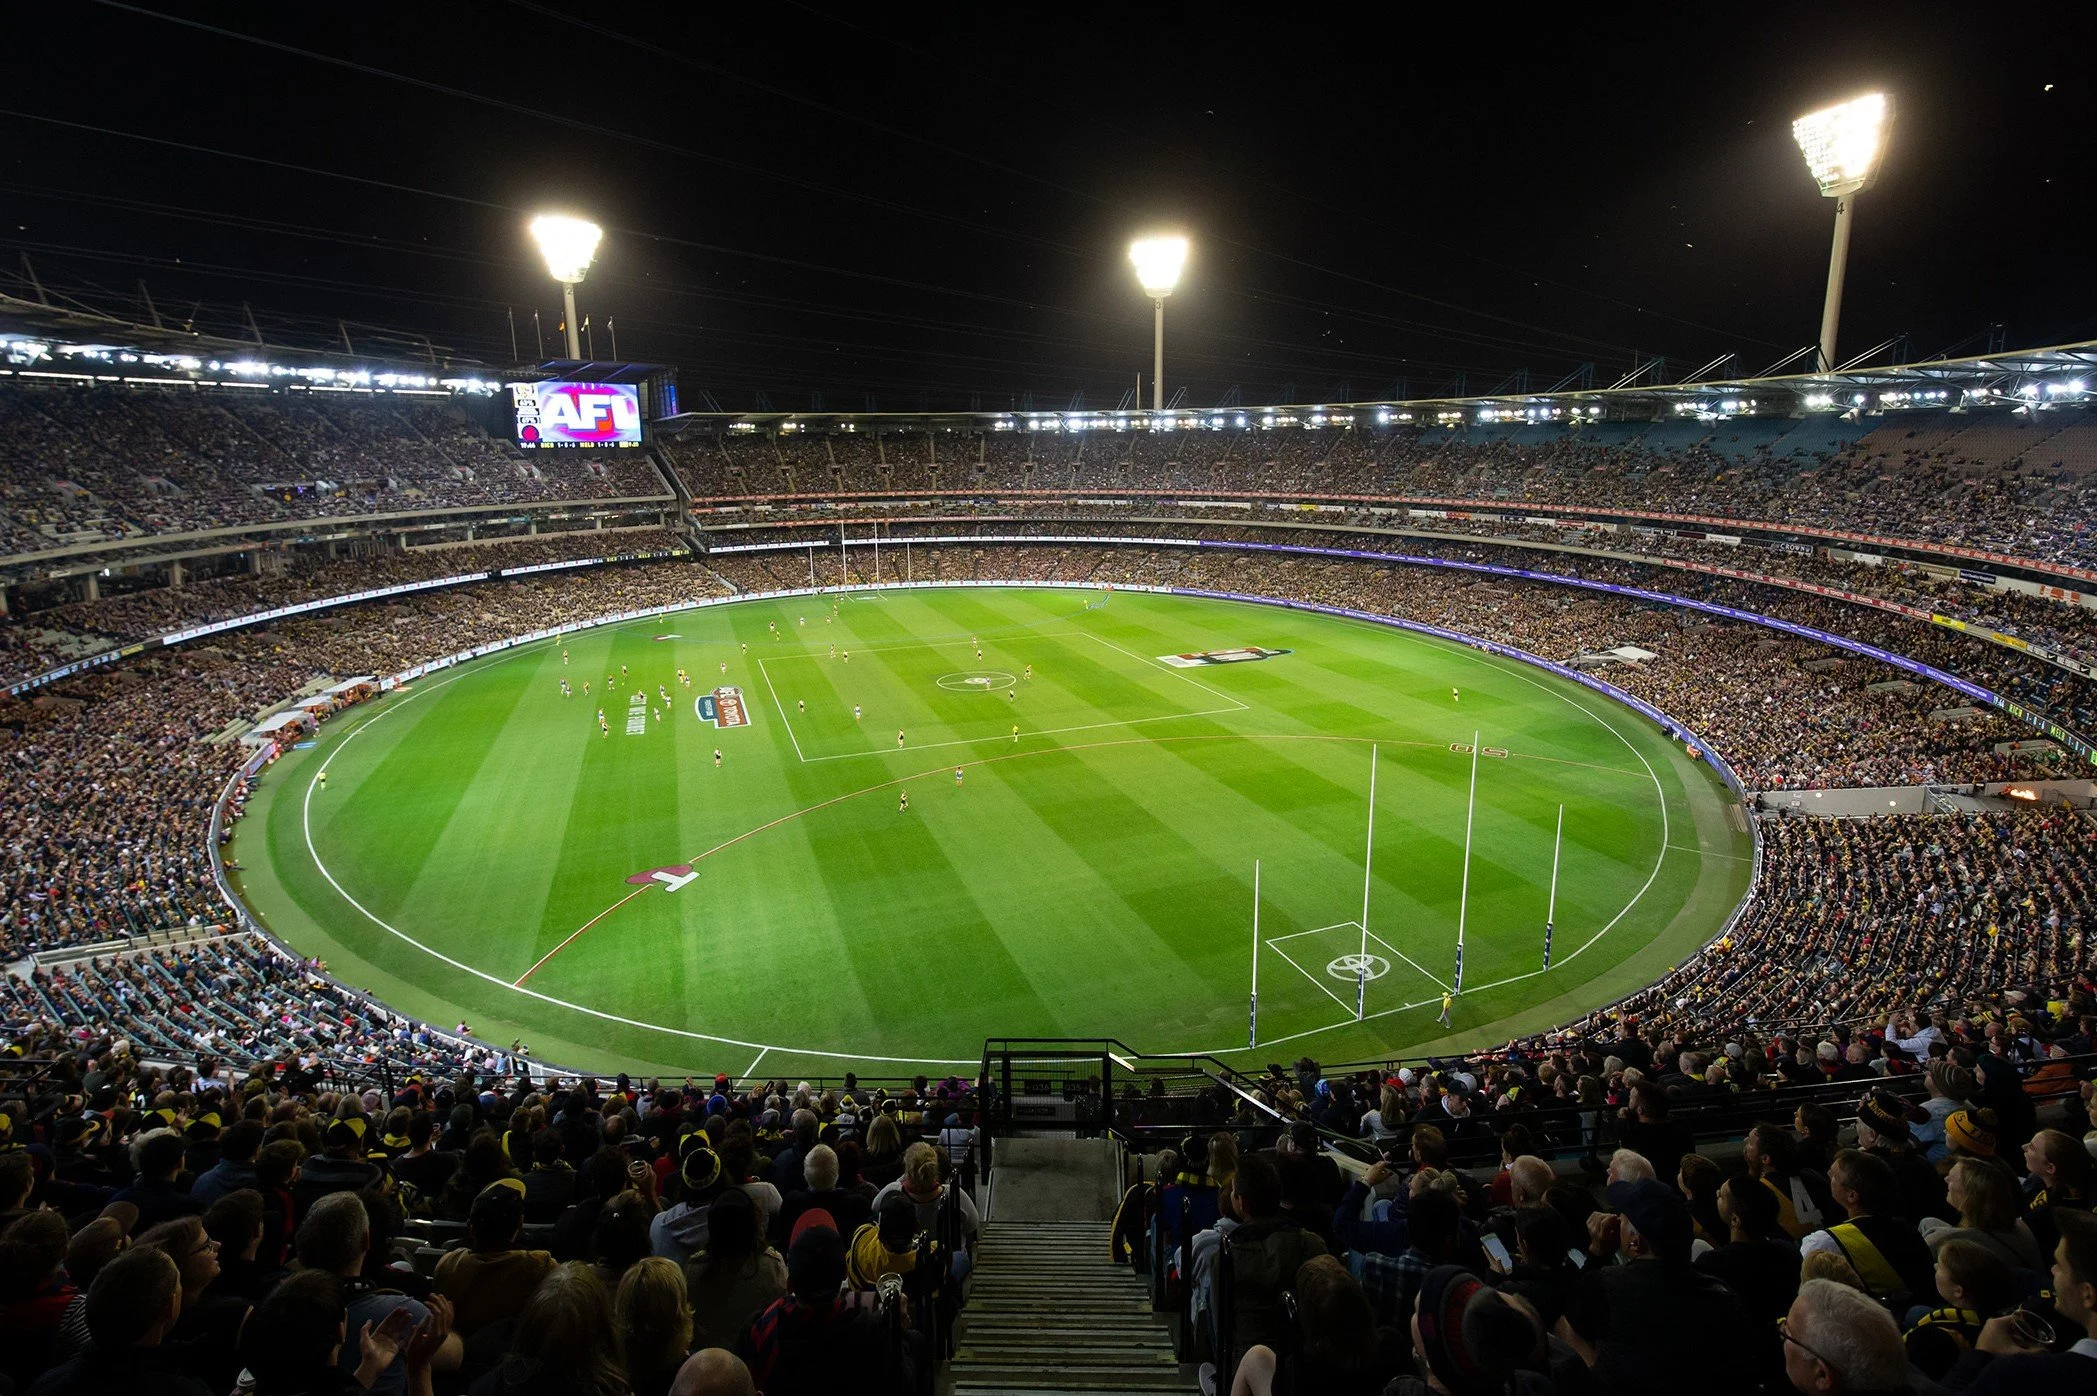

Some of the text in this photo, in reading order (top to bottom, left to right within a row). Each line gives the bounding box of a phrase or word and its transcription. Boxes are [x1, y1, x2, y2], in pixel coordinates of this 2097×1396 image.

[541, 393, 640, 430] AFL
[1780, 543, 1805, 551] CROWN
[1789, 1176, 1824, 1225] 4
